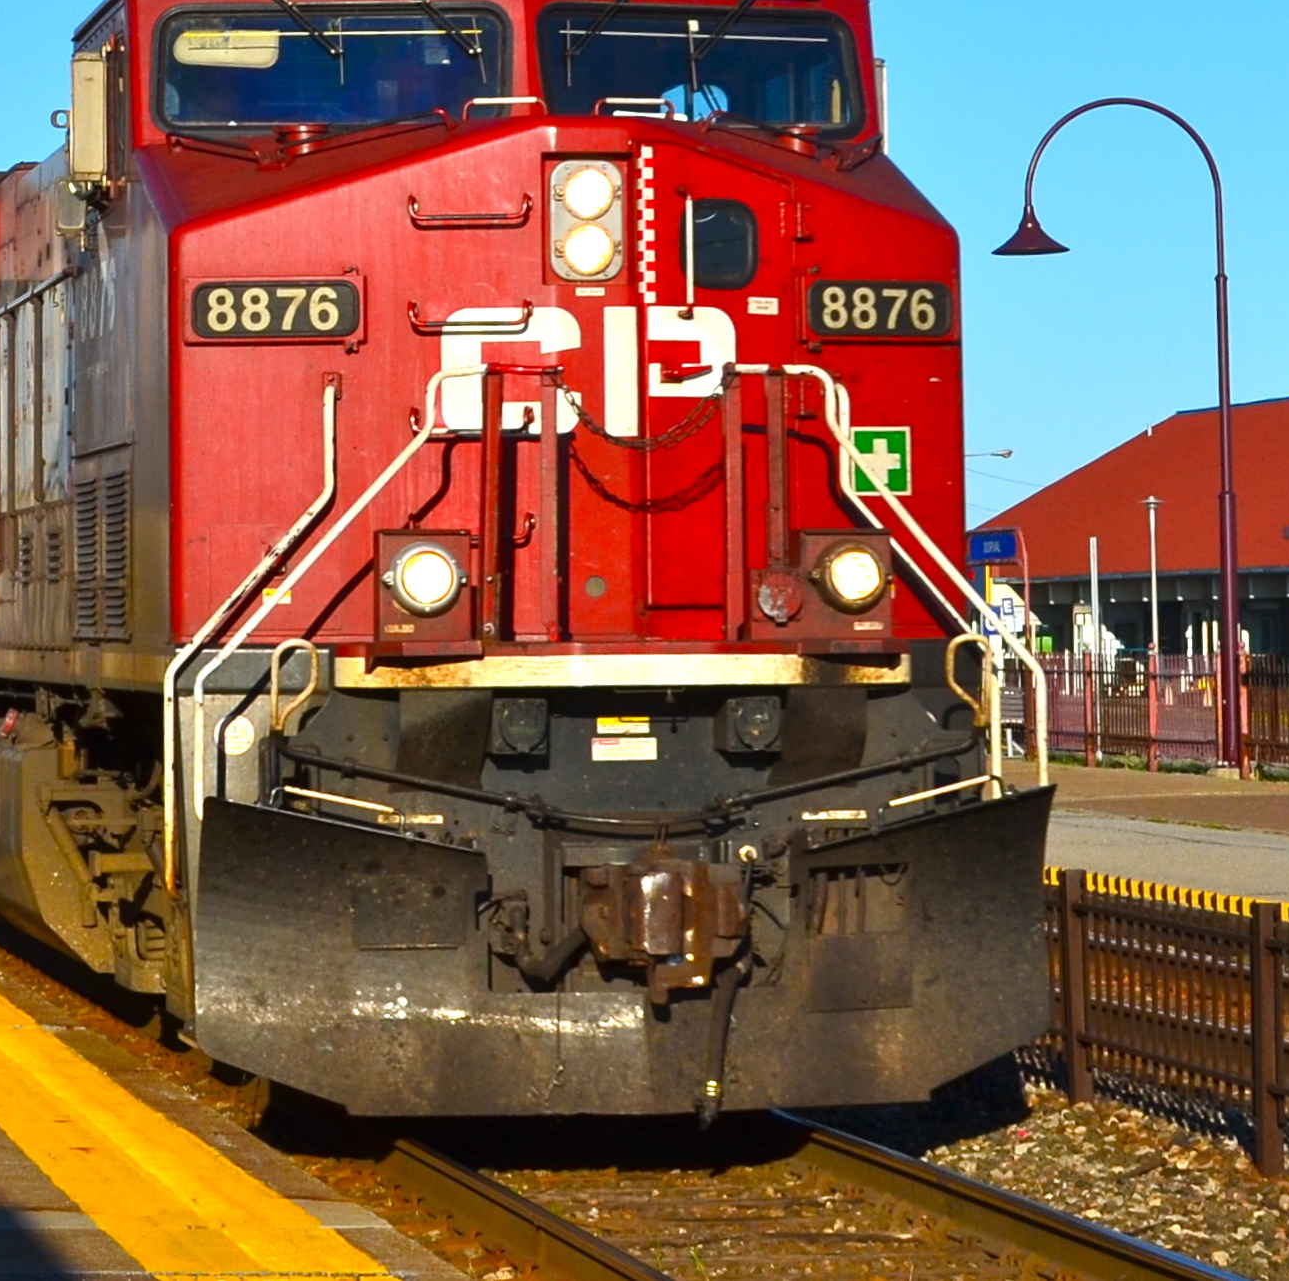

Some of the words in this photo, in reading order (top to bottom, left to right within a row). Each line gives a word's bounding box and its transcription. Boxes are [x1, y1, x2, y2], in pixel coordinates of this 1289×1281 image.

[80, 256, 117, 344] 8876
[207, 287, 340, 332] 8876
[821, 286, 937, 331] 8876
[1003, 600, 1013, 614] E
